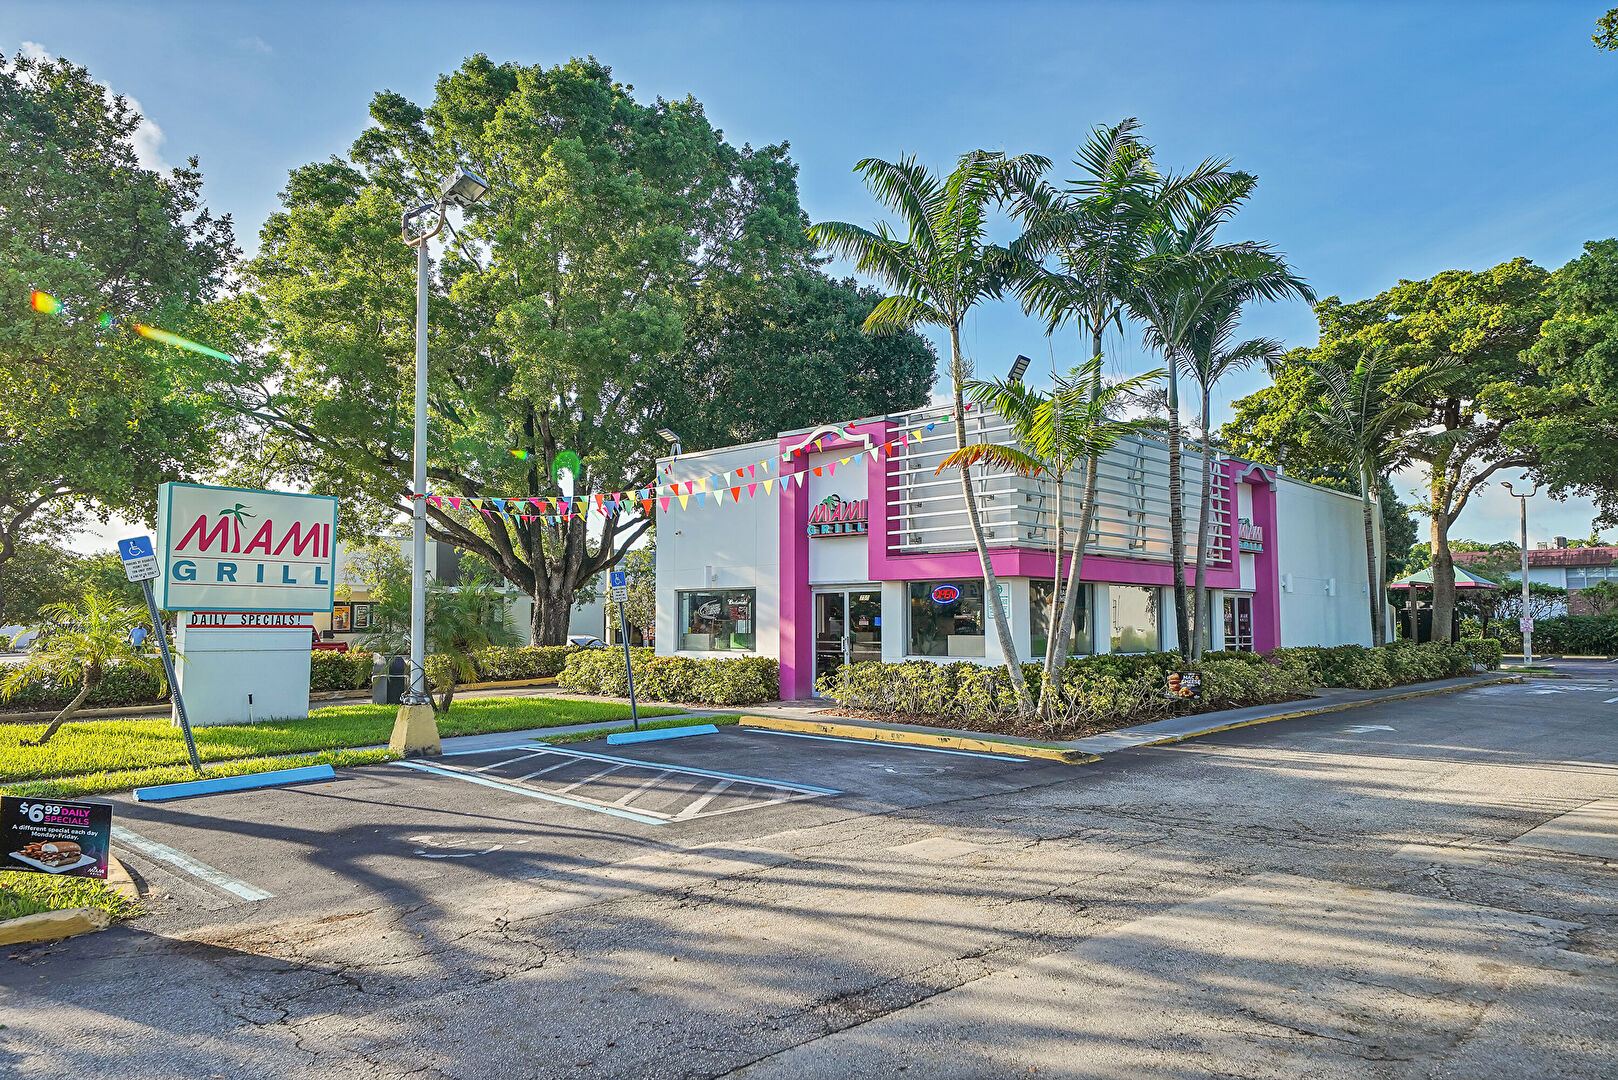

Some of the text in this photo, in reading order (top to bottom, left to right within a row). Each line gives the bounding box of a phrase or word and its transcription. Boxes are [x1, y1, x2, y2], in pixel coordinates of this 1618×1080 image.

[808, 500, 864, 522] MIAMI
[807, 522, 865, 535] GRILL
[174, 513, 330, 558] MIAMI
[172, 560, 328, 585] GRILL
[933, 589, 957, 600] OPEN
[191, 614, 301, 626] DAILY SPECIALS!
[61, 808, 91, 818] DAILY
[44, 815, 89, 826] SPECIALS
